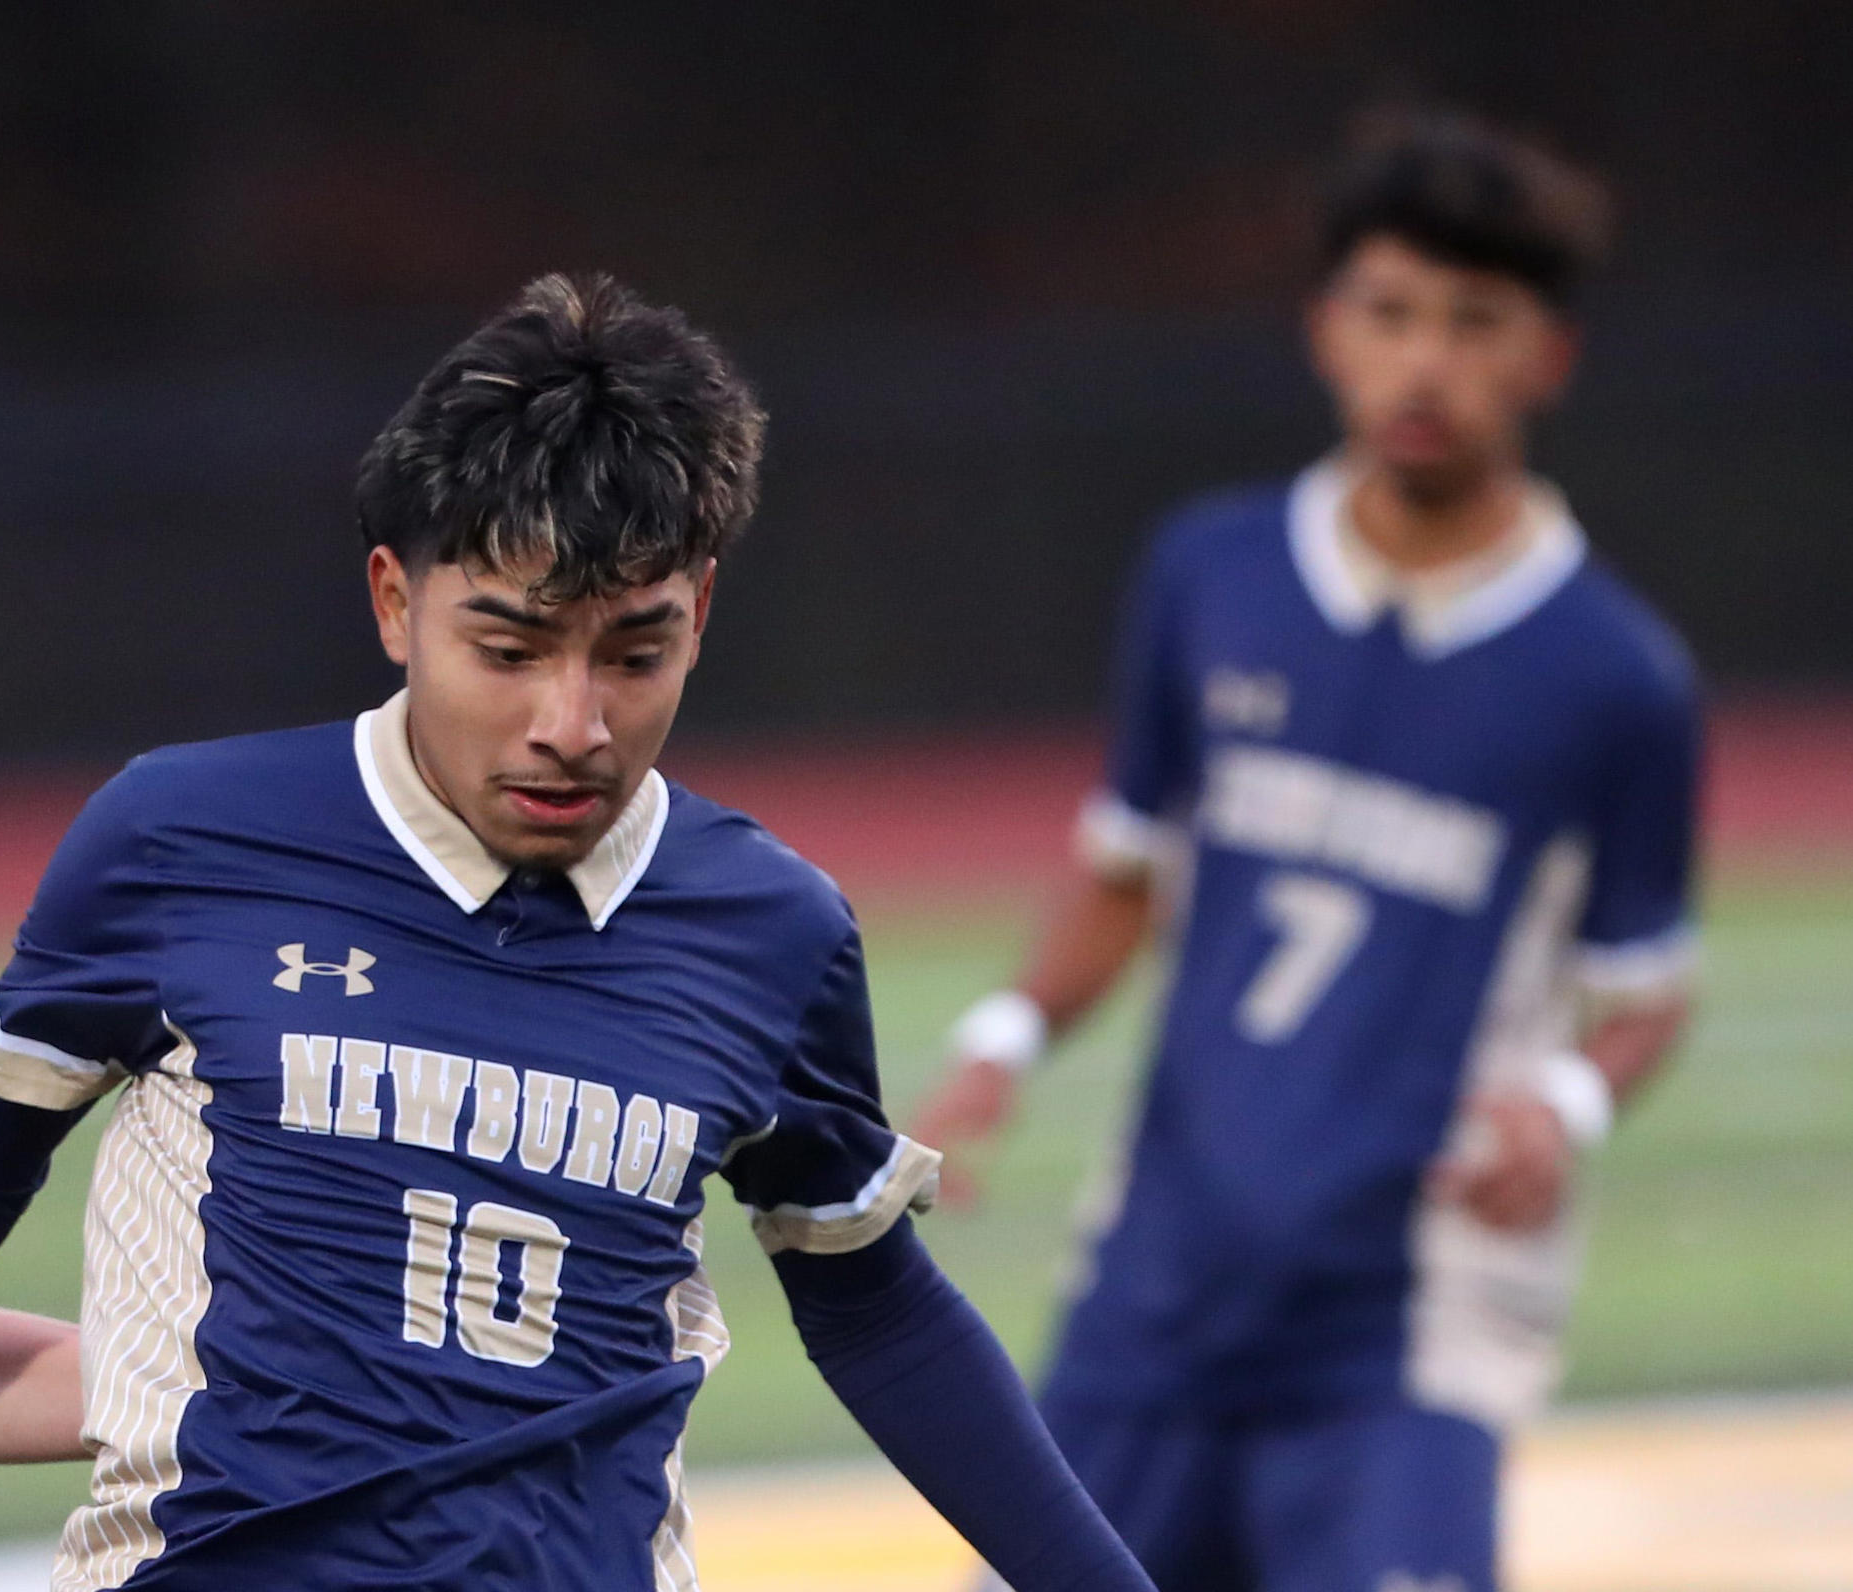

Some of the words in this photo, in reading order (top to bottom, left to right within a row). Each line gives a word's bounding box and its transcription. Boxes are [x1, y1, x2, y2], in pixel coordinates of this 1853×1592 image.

[1238, 868, 1373, 1043] 7
[280, 1033, 699, 1208] NEWBURGH
[403, 1188, 571, 1368] 10
